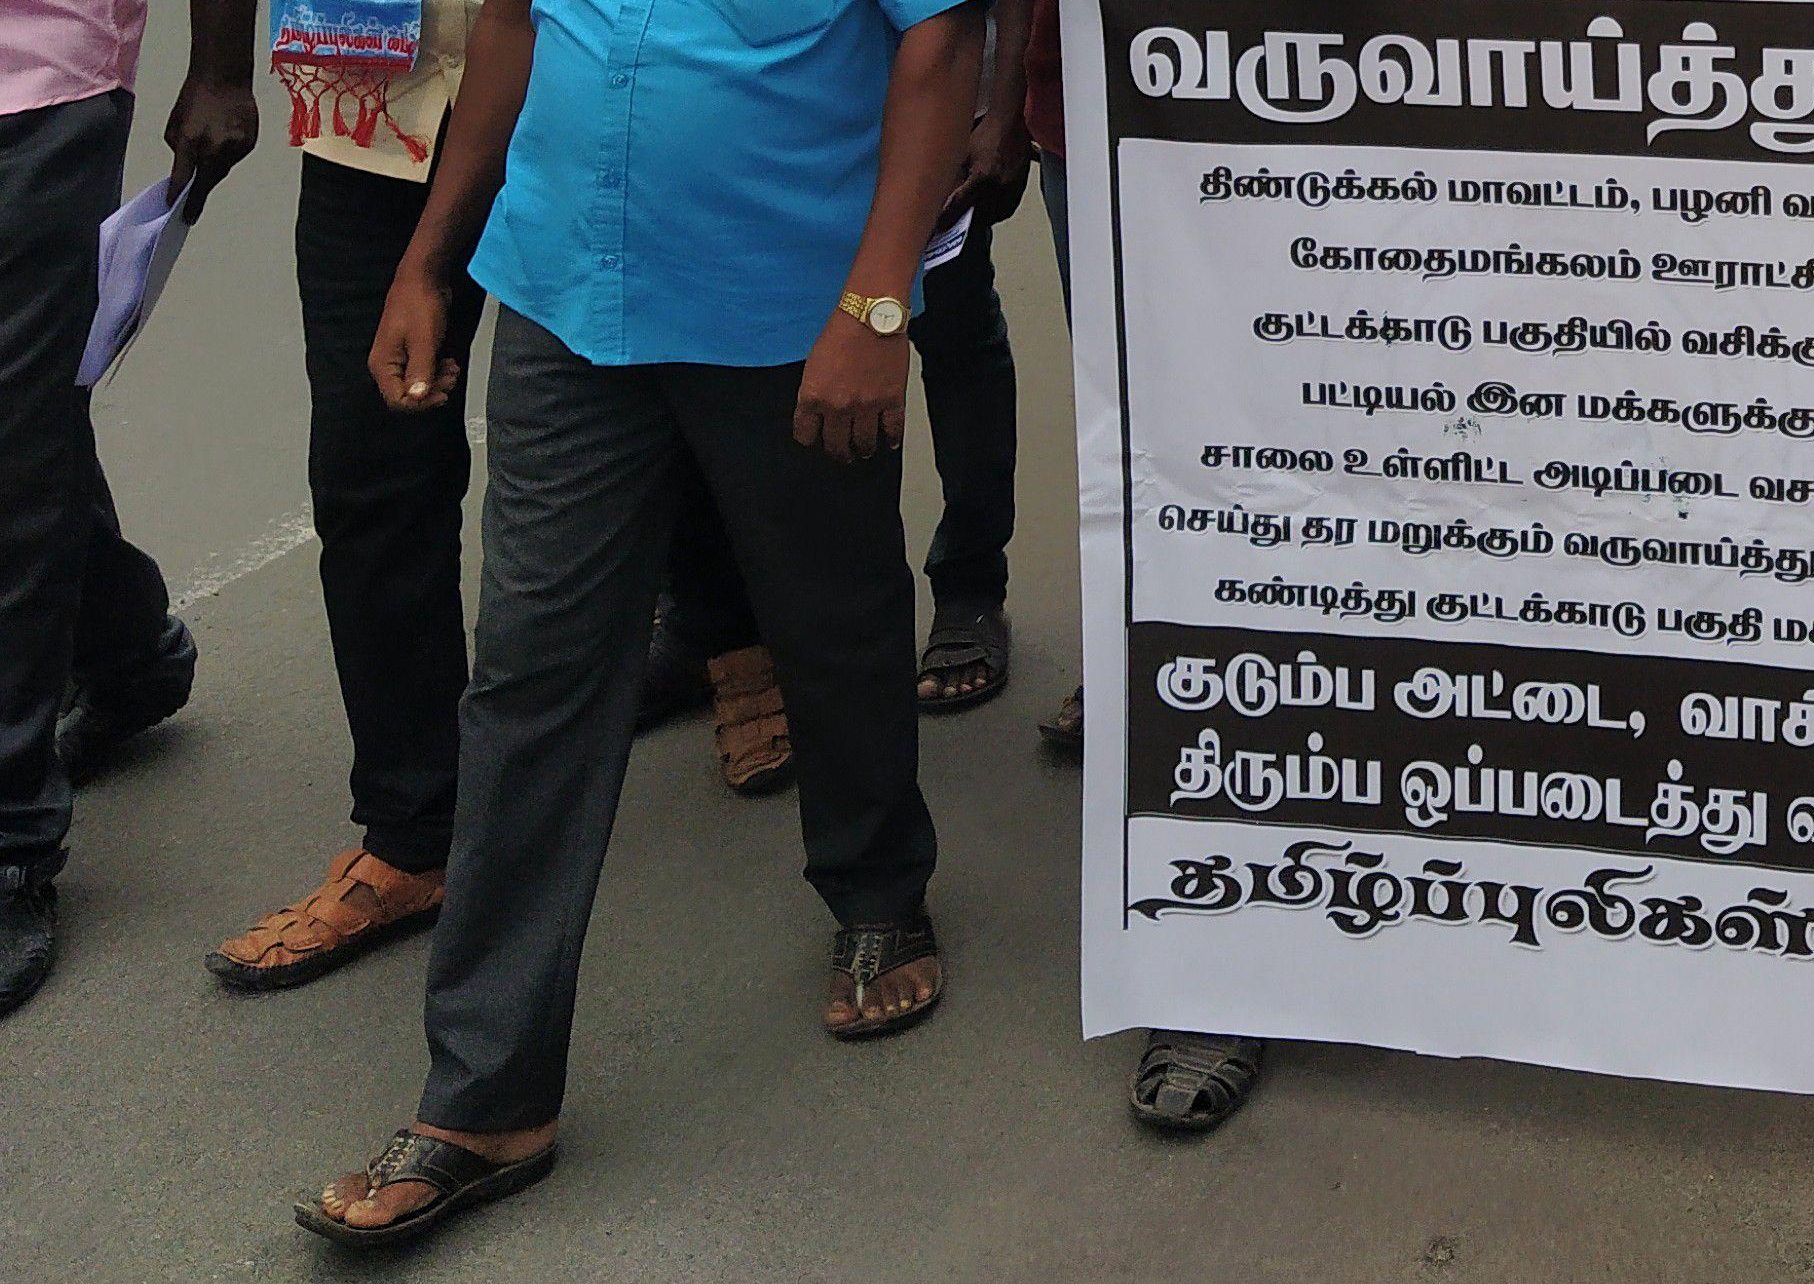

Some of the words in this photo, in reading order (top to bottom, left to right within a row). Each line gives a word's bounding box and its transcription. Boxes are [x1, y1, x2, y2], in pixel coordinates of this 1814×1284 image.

[1200, 165, 1437, 205] திண்டுக்கல்
[1449, 177, 1640, 213] மாவட்டம்,
[1653, 186, 1770, 223] பழனி
[1290, 237, 1641, 283] கோதைமங்கலம்
[1483, 316, 1672, 357] பகுதியில்
[1302, 381, 1455, 414] பட்டியல்
[1467, 383, 1566, 417] இன
[1200, 443, 1333, 474] சாலை
[1343, 449, 1523, 485] உள்ளிட்ட
[1534, 460, 1738, 496] அடிப்படை
[1159, 502, 1291, 545] செய்து
[1303, 516, 1359, 547] தர
[1368, 519, 1554, 558] மறுக்கும்
[1215, 576, 1415, 622] கண்டித்து
[1427, 590, 1647, 635] குட்டக்காடு
[1658, 605, 1763, 645] பகுதி
[1156, 650, 1375, 717] குடும்ப
[1394, 666, 1646, 739] அட்டை,
[1170, 728, 1382, 812] திரும்ப
[1401, 744, 1767, 855] ஒப்படைத்து
